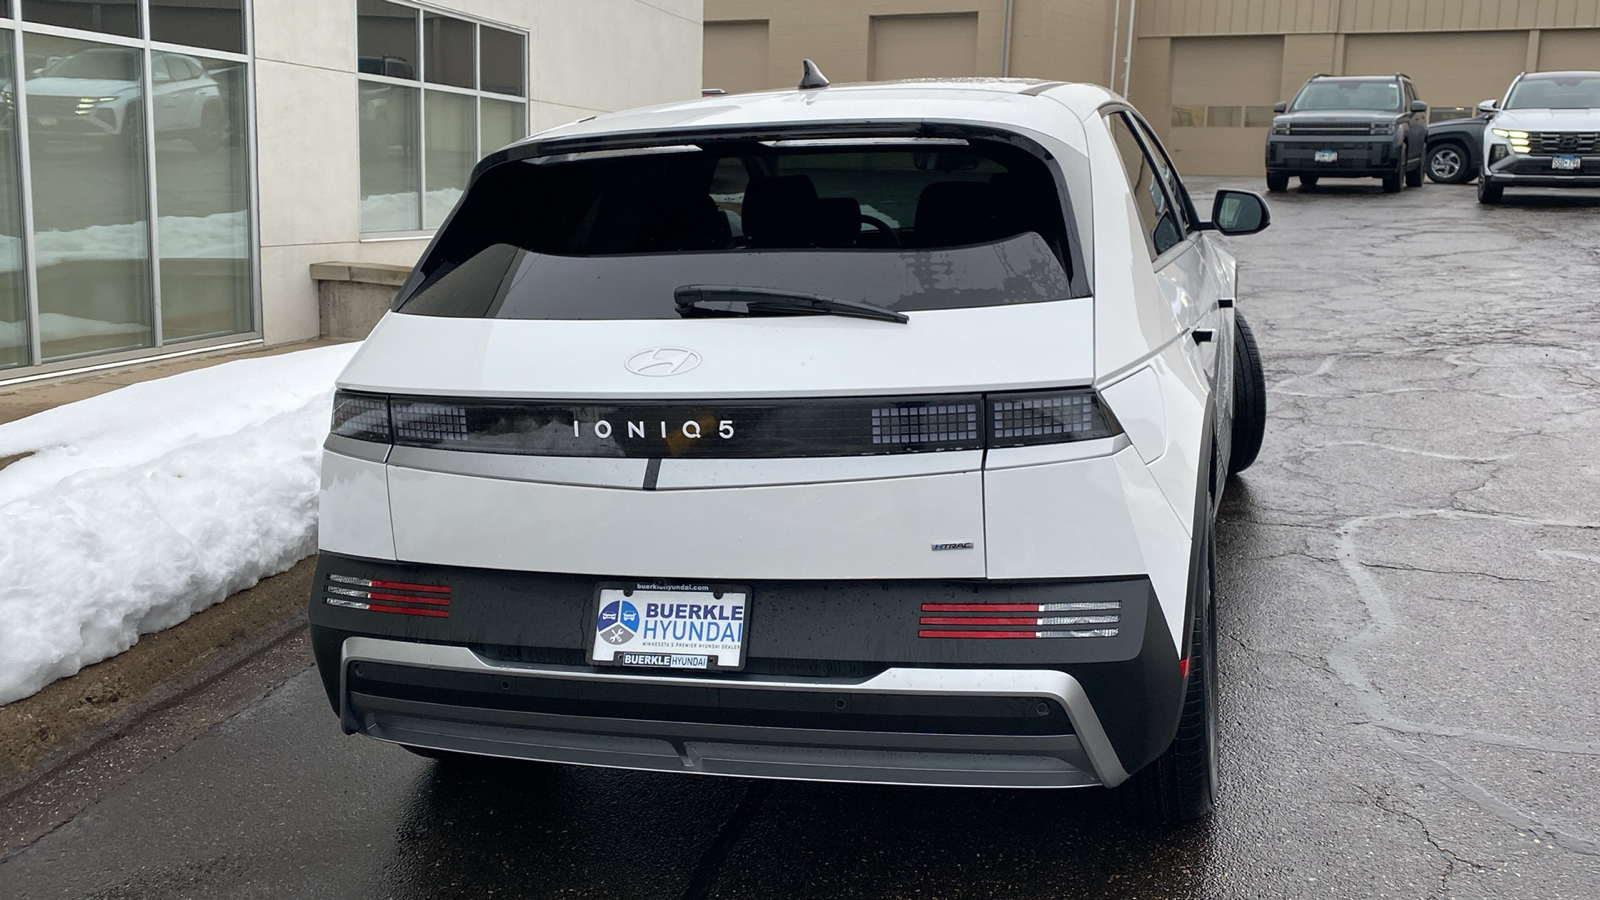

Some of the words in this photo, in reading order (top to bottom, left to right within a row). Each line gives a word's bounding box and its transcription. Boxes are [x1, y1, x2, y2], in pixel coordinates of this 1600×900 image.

[573, 420, 701, 439] IONIQ
[718, 420, 734, 439] 5
[934, 542, 972, 550] HTRAC
[645, 603, 744, 621] BUERKLE
[643, 620, 742, 643] HYUNDAI
[624, 653, 671, 666] BUERKLE
[671, 655, 706, 667] HYUNDAI
